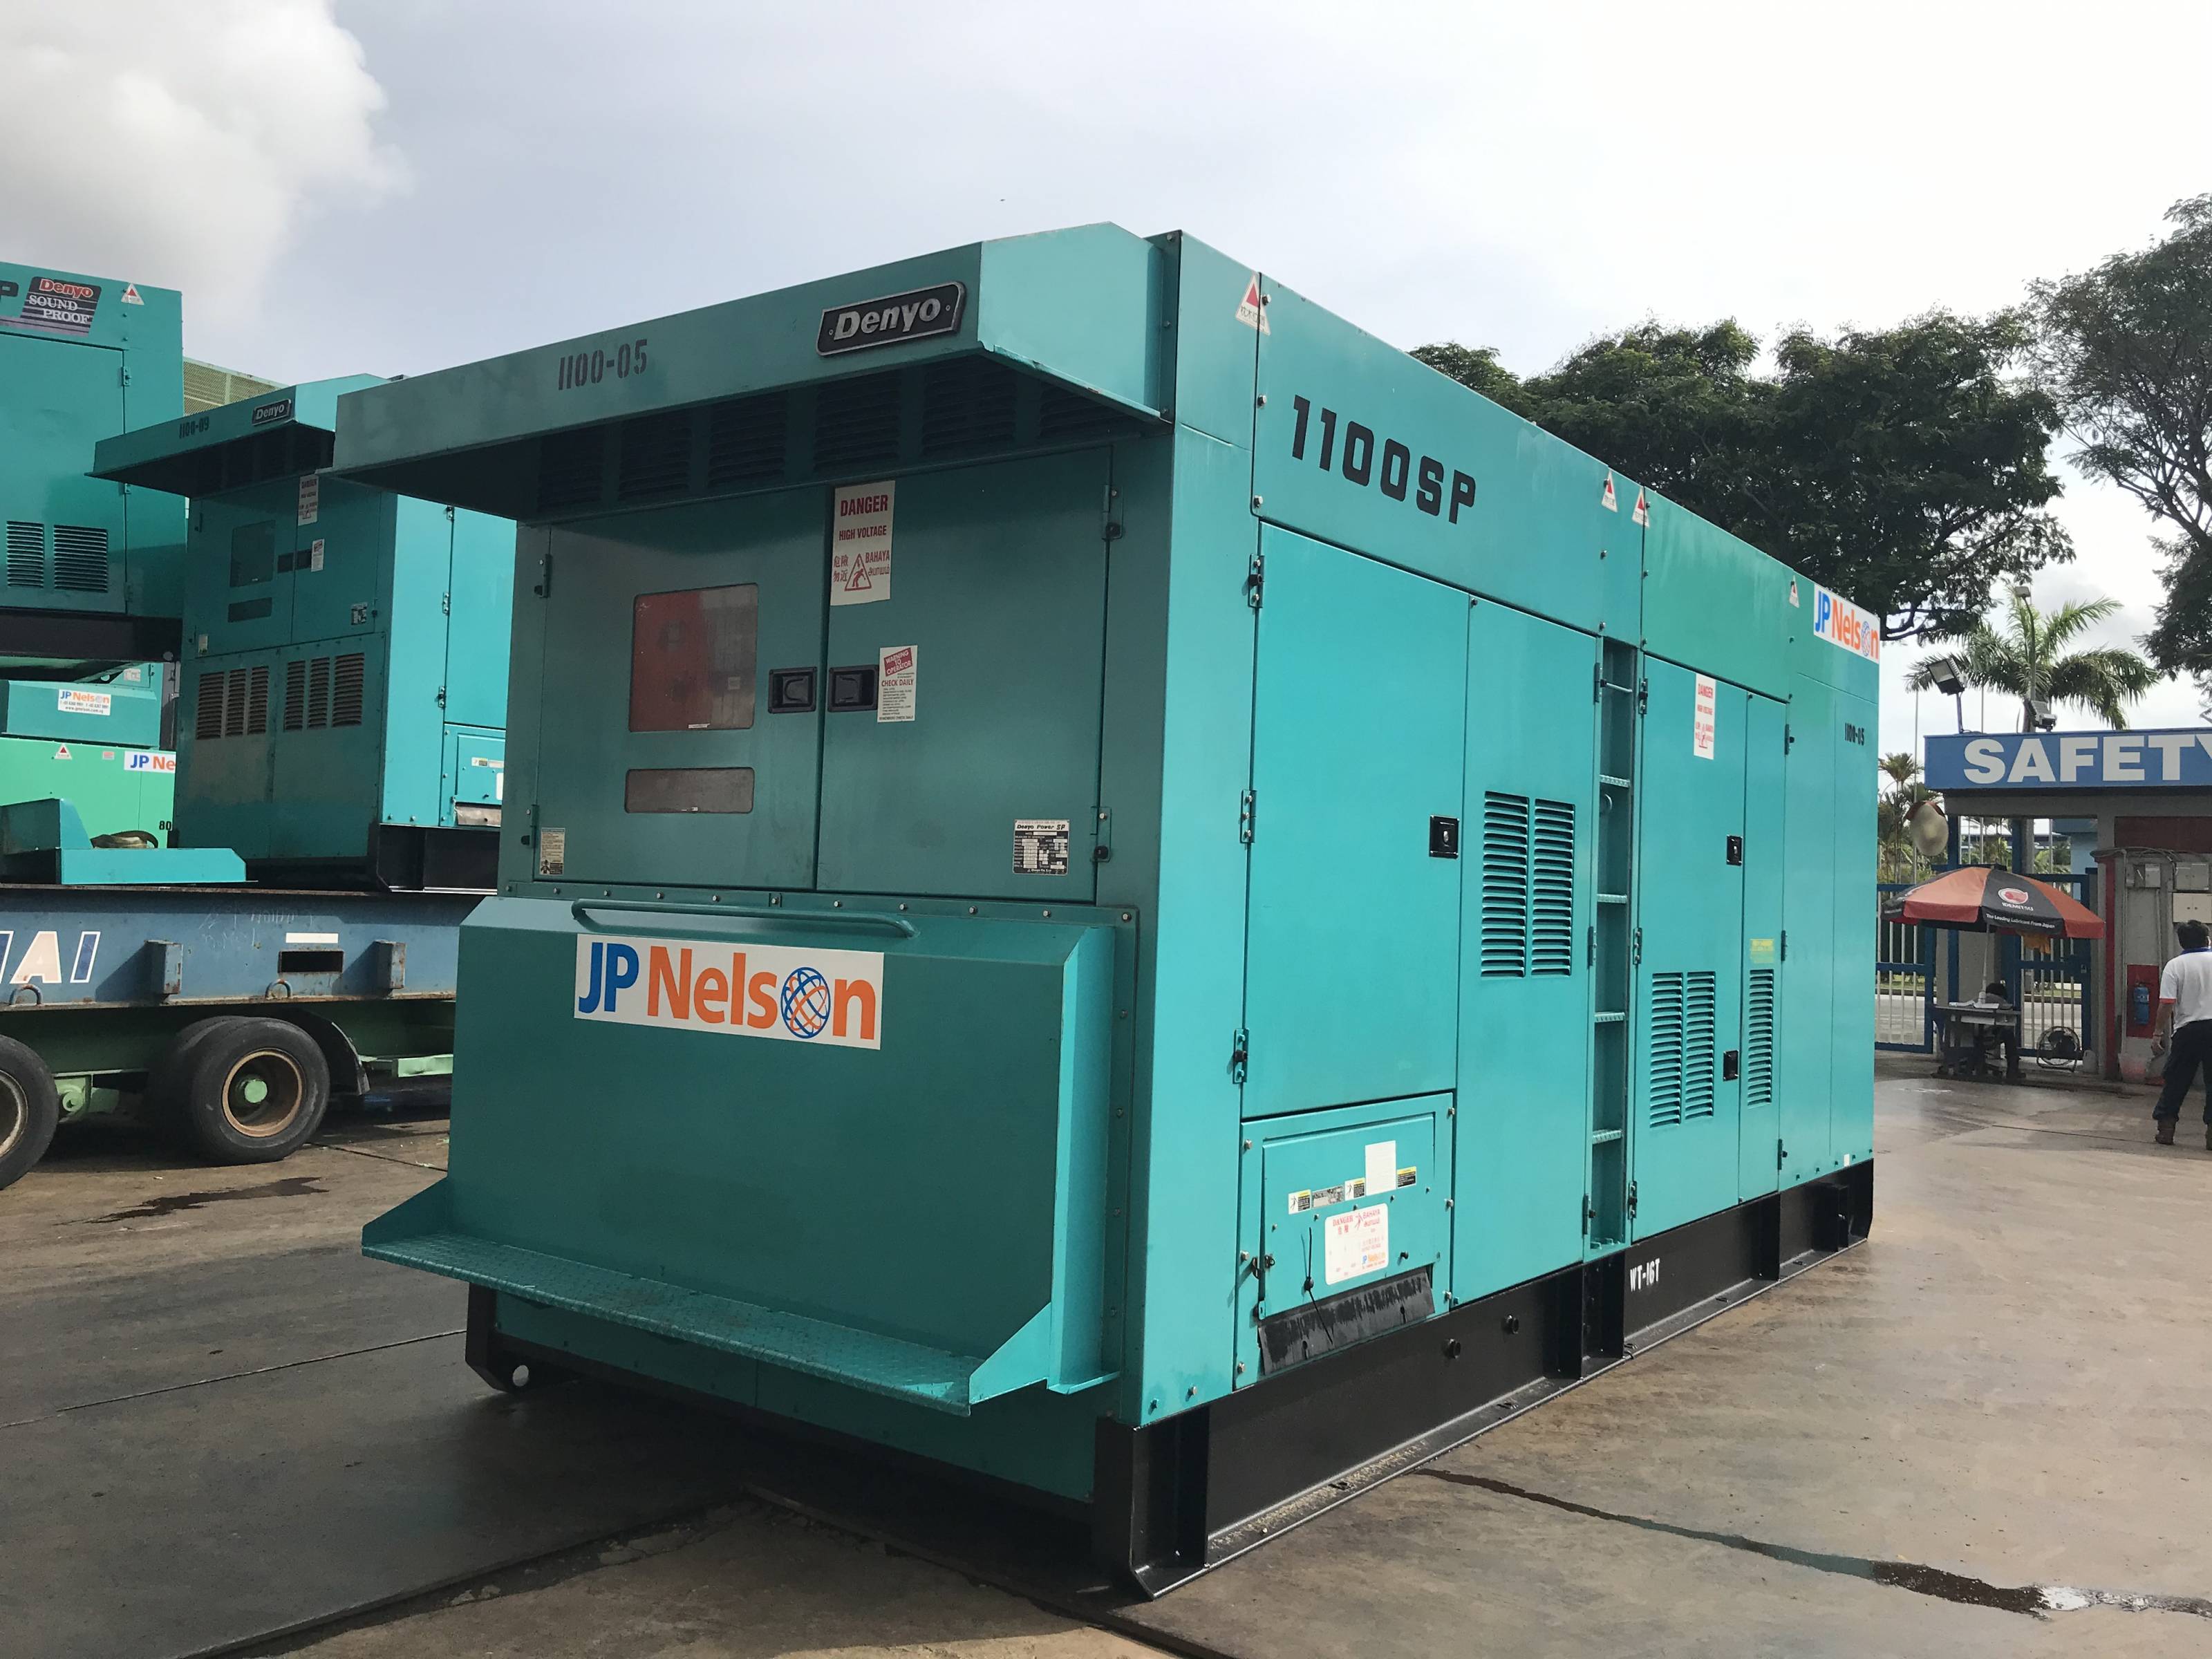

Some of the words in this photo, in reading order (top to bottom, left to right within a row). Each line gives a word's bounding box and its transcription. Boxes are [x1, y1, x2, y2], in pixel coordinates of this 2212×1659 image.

[39, 279, 93, 299] Denyo
[29, 294, 78, 311] SOUND
[42, 308, 90, 324] PROOF
[834, 298, 941, 341] Denyo
[559, 339, 647, 391] 1100-05
[256, 404, 285, 420] Denyo
[1292, 394, 1476, 525] 1100SP
[840, 494, 888, 517] DANGER
[838, 528, 856, 541] HIGH
[857, 525, 887, 538] VOLTAGE
[865, 550, 890, 563] BAHAYA
[1815, 590, 1830, 633] JP
[1831, 599, 1879, 659] Nelson
[885, 650, 909, 664] WARNING
[886, 660, 912, 675] OPERATOR
[60, 691, 72, 700] JP
[73, 692, 110, 704] Nelson
[1845, 722, 1864, 746] 1100-05
[130, 754, 149, 769] JP
[2002, 902, 2034, 911] IDEMITSU
[579, 941, 639, 1014] JP
[647, 945, 877, 1040] Nelson
[1333, 1215, 1353, 1226] DANGER
